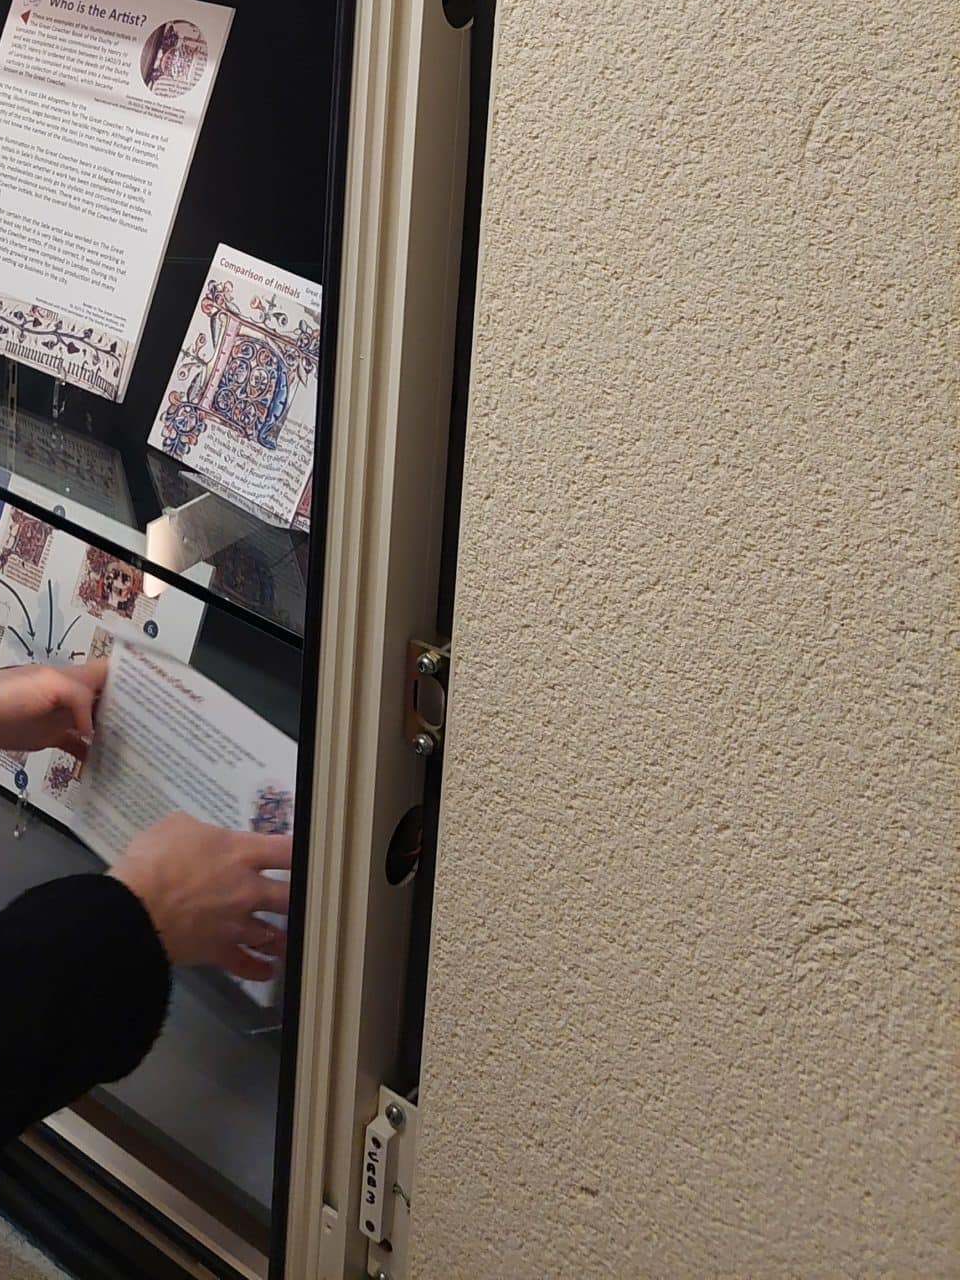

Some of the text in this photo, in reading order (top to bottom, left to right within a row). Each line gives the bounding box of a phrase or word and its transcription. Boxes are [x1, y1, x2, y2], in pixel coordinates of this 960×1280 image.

[76, 0, 86, 14] is
[88, 3, 106, 19] the
[108, 8, 148, 27] Artist?
[219, 257, 301, 299] Comparison of Initials
